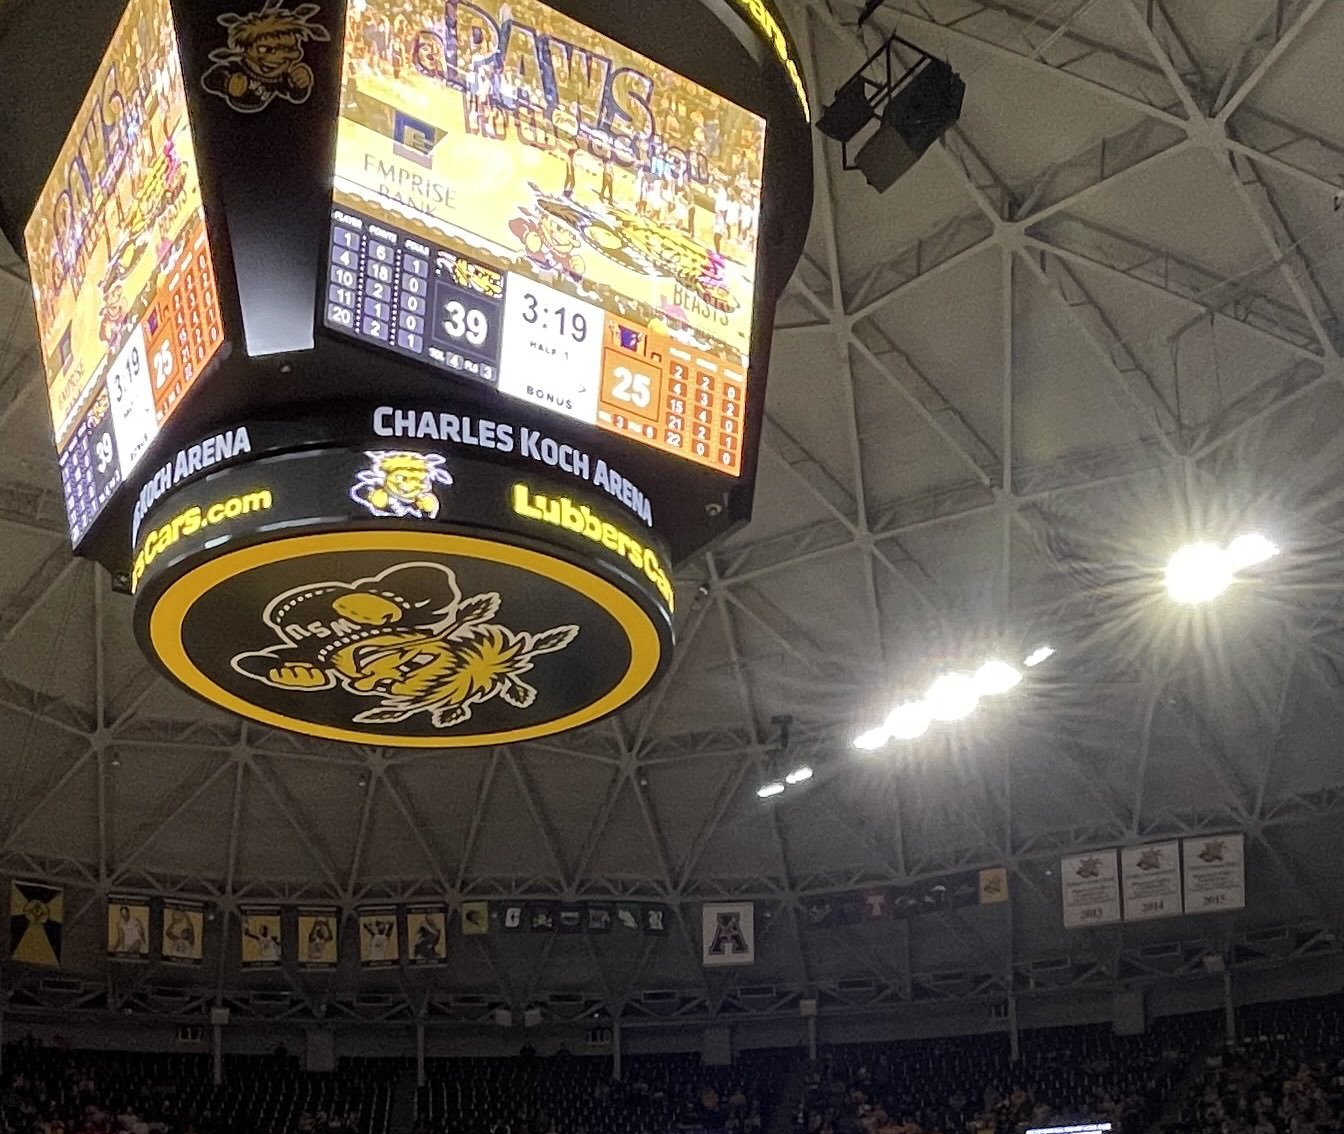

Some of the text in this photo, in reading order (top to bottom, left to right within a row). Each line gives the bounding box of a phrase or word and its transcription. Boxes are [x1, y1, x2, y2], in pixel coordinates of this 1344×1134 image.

[363, 153, 457, 209] EMPRISE
[336, 268, 353, 286] 10
[337, 288, 352, 305] 11
[332, 306, 351, 324] 20
[442, 299, 489, 346] 39
[522, 293, 587, 343] 3:19
[526, 385, 573, 410] BONUS
[611, 366, 651, 408] 25
[95, 432, 114, 473] 39
[173, 426, 252, 484] ARENA
[372, 405, 654, 527] CHARLES KOCH ARENA
[511, 480, 675, 614] LubbersCa
